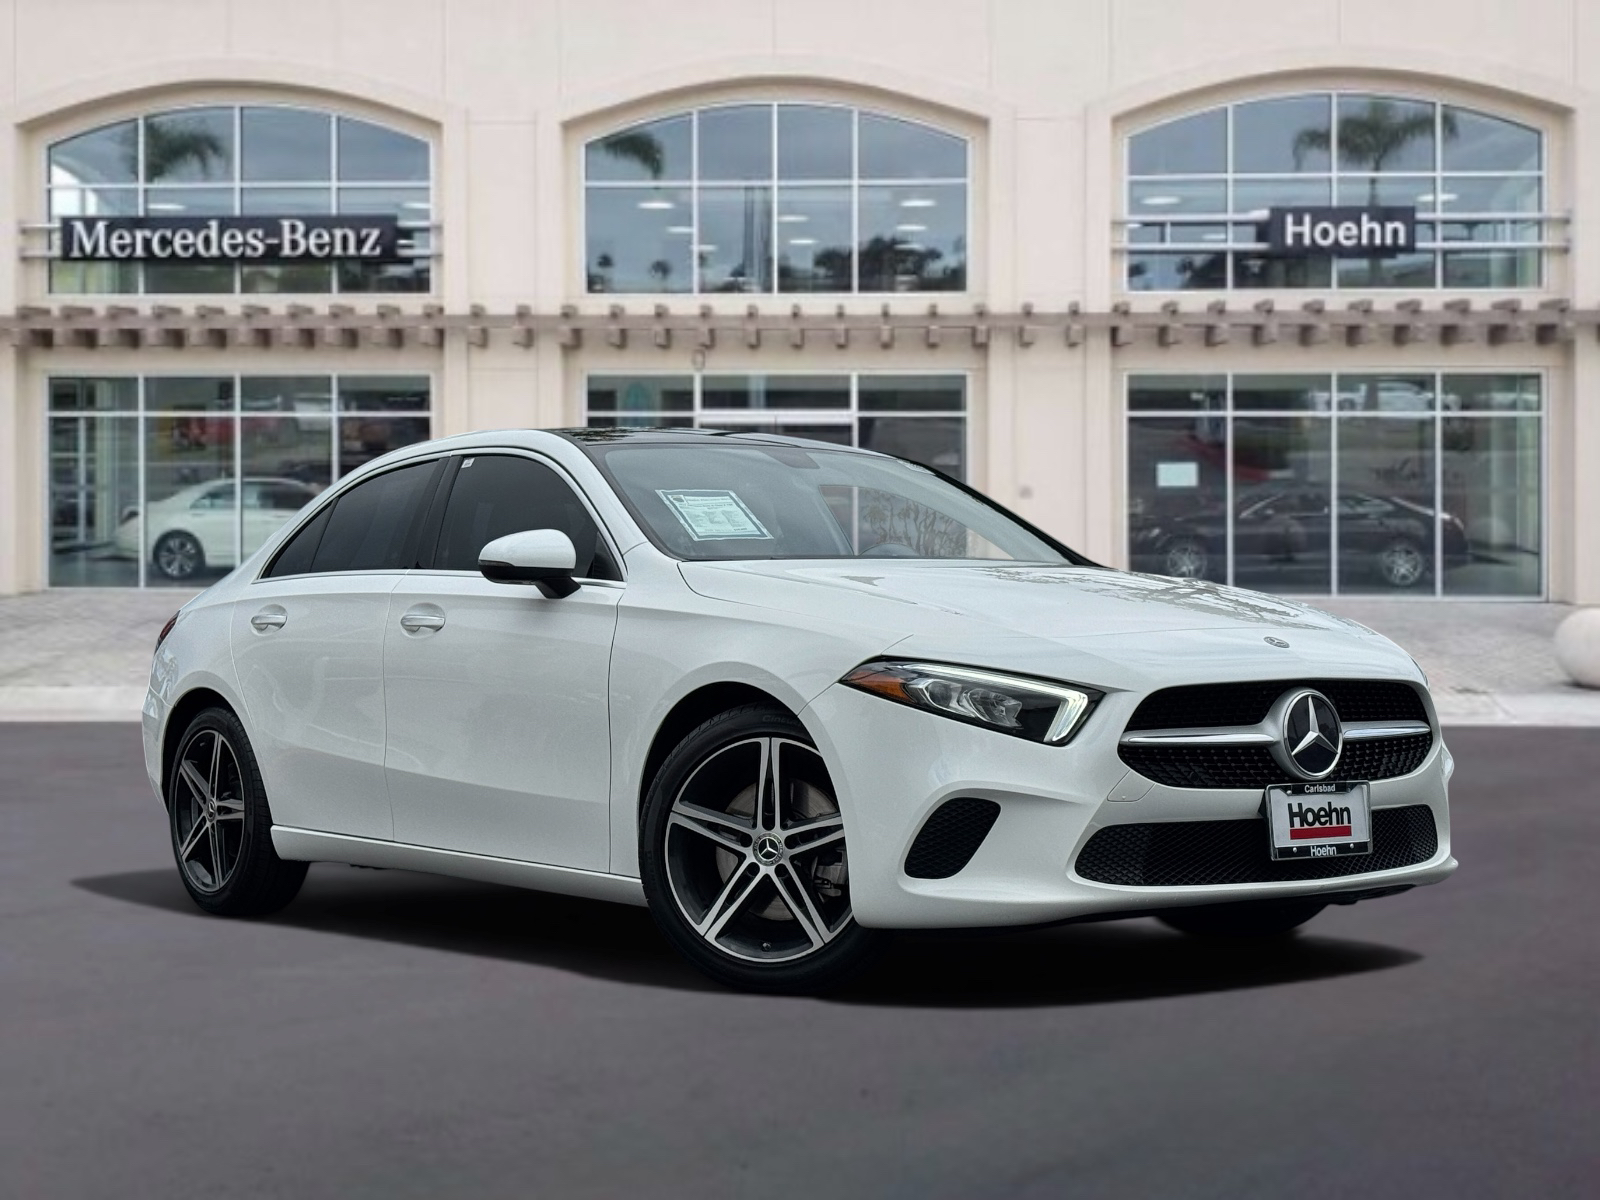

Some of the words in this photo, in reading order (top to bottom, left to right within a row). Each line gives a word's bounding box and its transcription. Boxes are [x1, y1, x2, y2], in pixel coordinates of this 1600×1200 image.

[69, 219, 382, 257] Mercedes-Benz
[1285, 212, 1406, 246] Hoehn
[1304, 783, 1336, 793] Carlsbad
[1287, 801, 1352, 828] Hoehn
[1310, 845, 1337, 857] Hoehn
